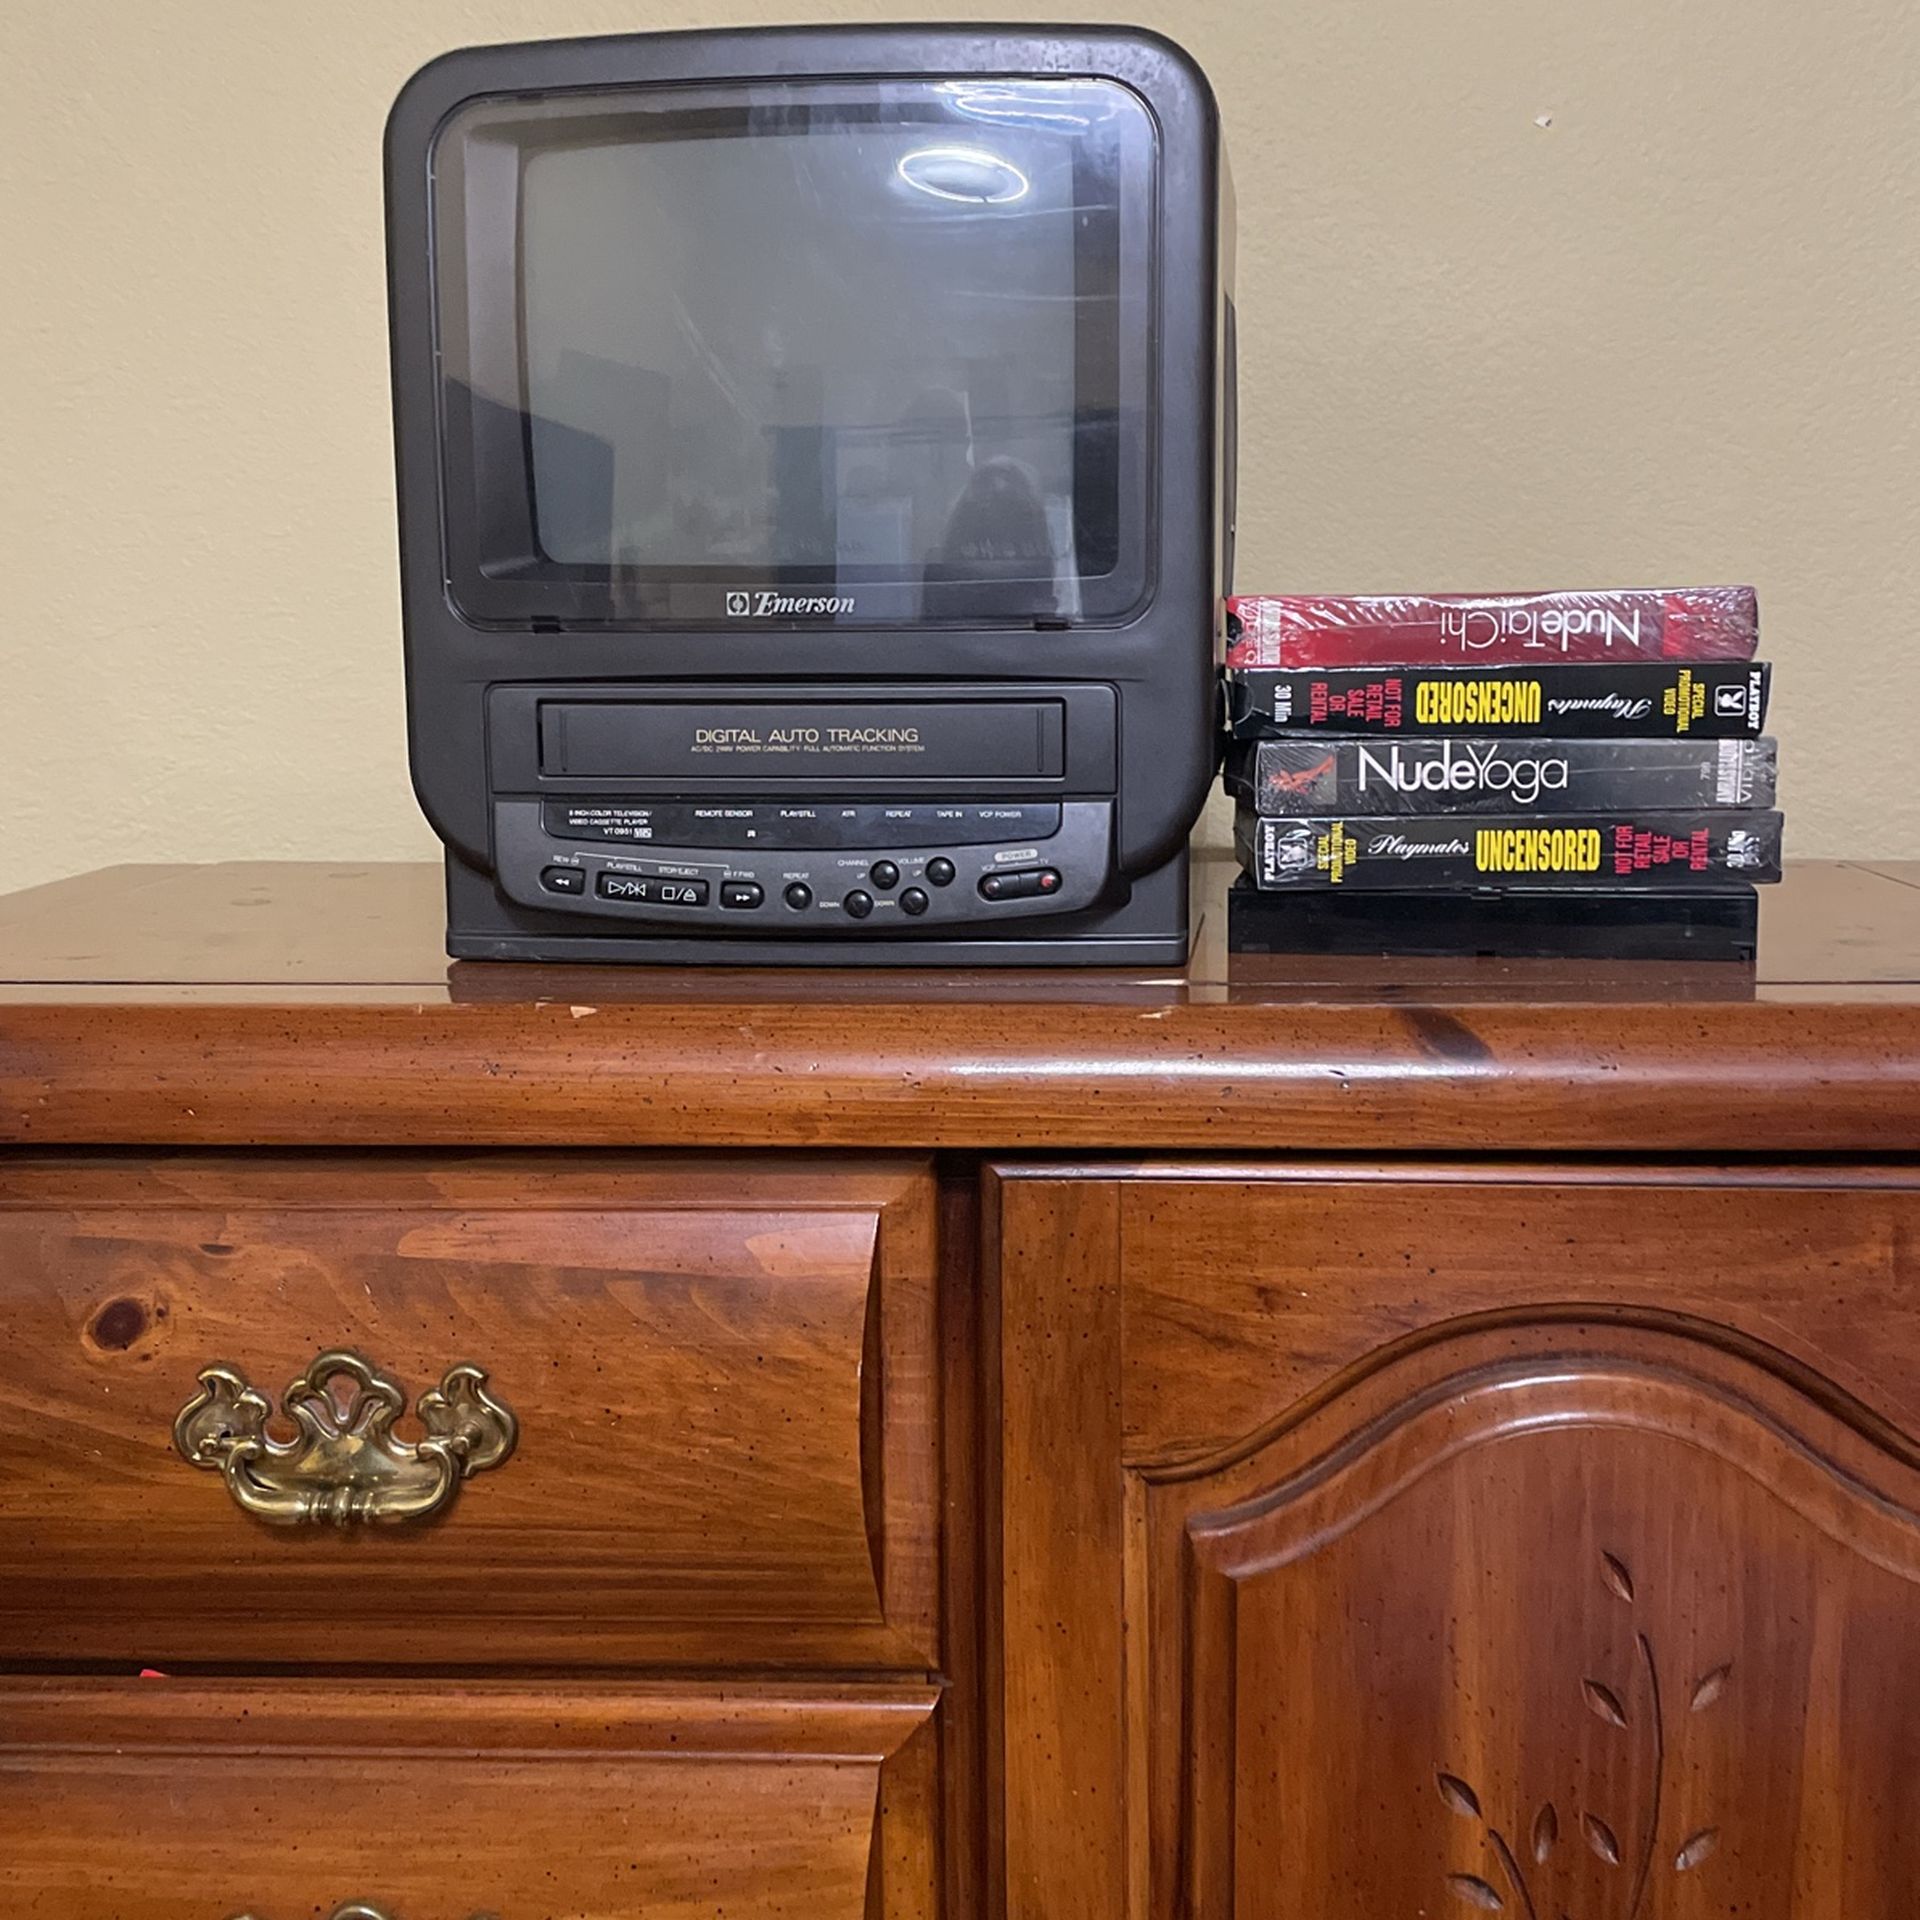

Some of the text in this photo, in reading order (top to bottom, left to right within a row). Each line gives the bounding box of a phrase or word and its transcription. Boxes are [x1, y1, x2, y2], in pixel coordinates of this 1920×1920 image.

[753, 591, 855, 616] Emerson
[1274, 685, 1292, 722] 30 Min
[1310, 682, 1328, 724] RENTAL
[1329, 695, 1346, 712] OR
[1347, 689, 1364, 717] SALE
[1366, 684, 1383, 722] RETAIL
[1384, 678, 1402, 728] NOT FOR
[1416, 681, 1541, 724] UNCENSORED
[1548, 693, 1652, 719] Playmates
[1663, 688, 1676, 715] VIDEO
[1676, 669, 1691, 733] PROMOTIONAL
[1692, 683, 1705, 719] SPECIAL
[1748, 671, 1760, 729] PLAYBOY
[696, 728, 918, 743] DIGITAL AUTO TRACKING
[937, 810, 953, 818] TAPE
[838, 859, 869, 867] CHANNEL
[1040, 857, 1051, 865] TV
[1264, 825, 1275, 881] PLAYBOY
[1331, 821, 1344, 883] PROMOTIONAL
[1344, 838, 1357, 865] VIDEO
[1368, 834, 1469, 860] Playmates
[1476, 829, 1600, 871] UNCENSORED
[1615, 825, 1633, 874] NOT FOR
[1634, 832, 1652, 868] RETAIL
[1653, 835, 1670, 864] SALE
[1672, 841, 1689, 858] OR
[1690, 828, 1709, 870] RENTAL
